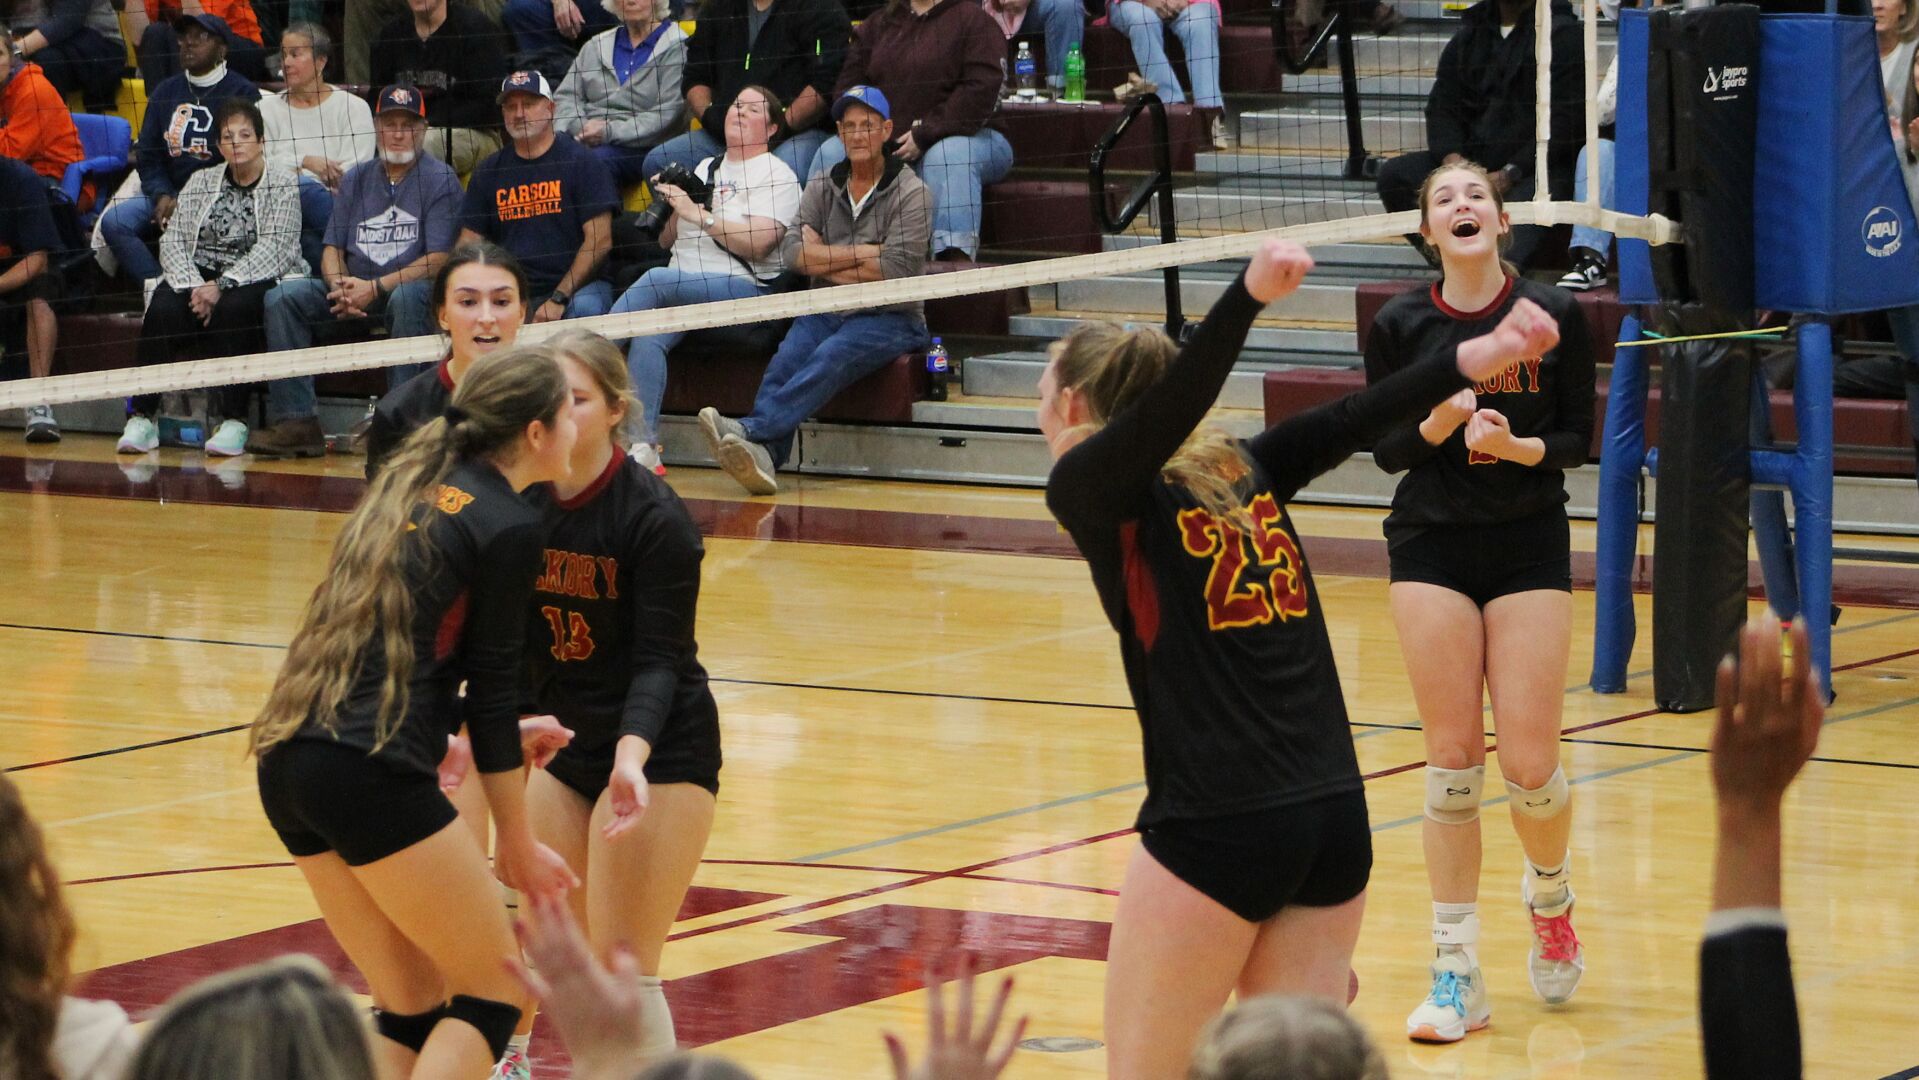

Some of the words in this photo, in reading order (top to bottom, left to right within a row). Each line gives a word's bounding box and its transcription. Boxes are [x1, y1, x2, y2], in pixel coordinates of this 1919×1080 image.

[1721, 76, 1748, 91] sports
[1722, 65, 1748, 80] jaypro
[496, 179, 562, 207] CARSON
[393, 222, 417, 241] OAK
[1176, 490, 1308, 632] 25
[541, 605, 596, 662] 13
